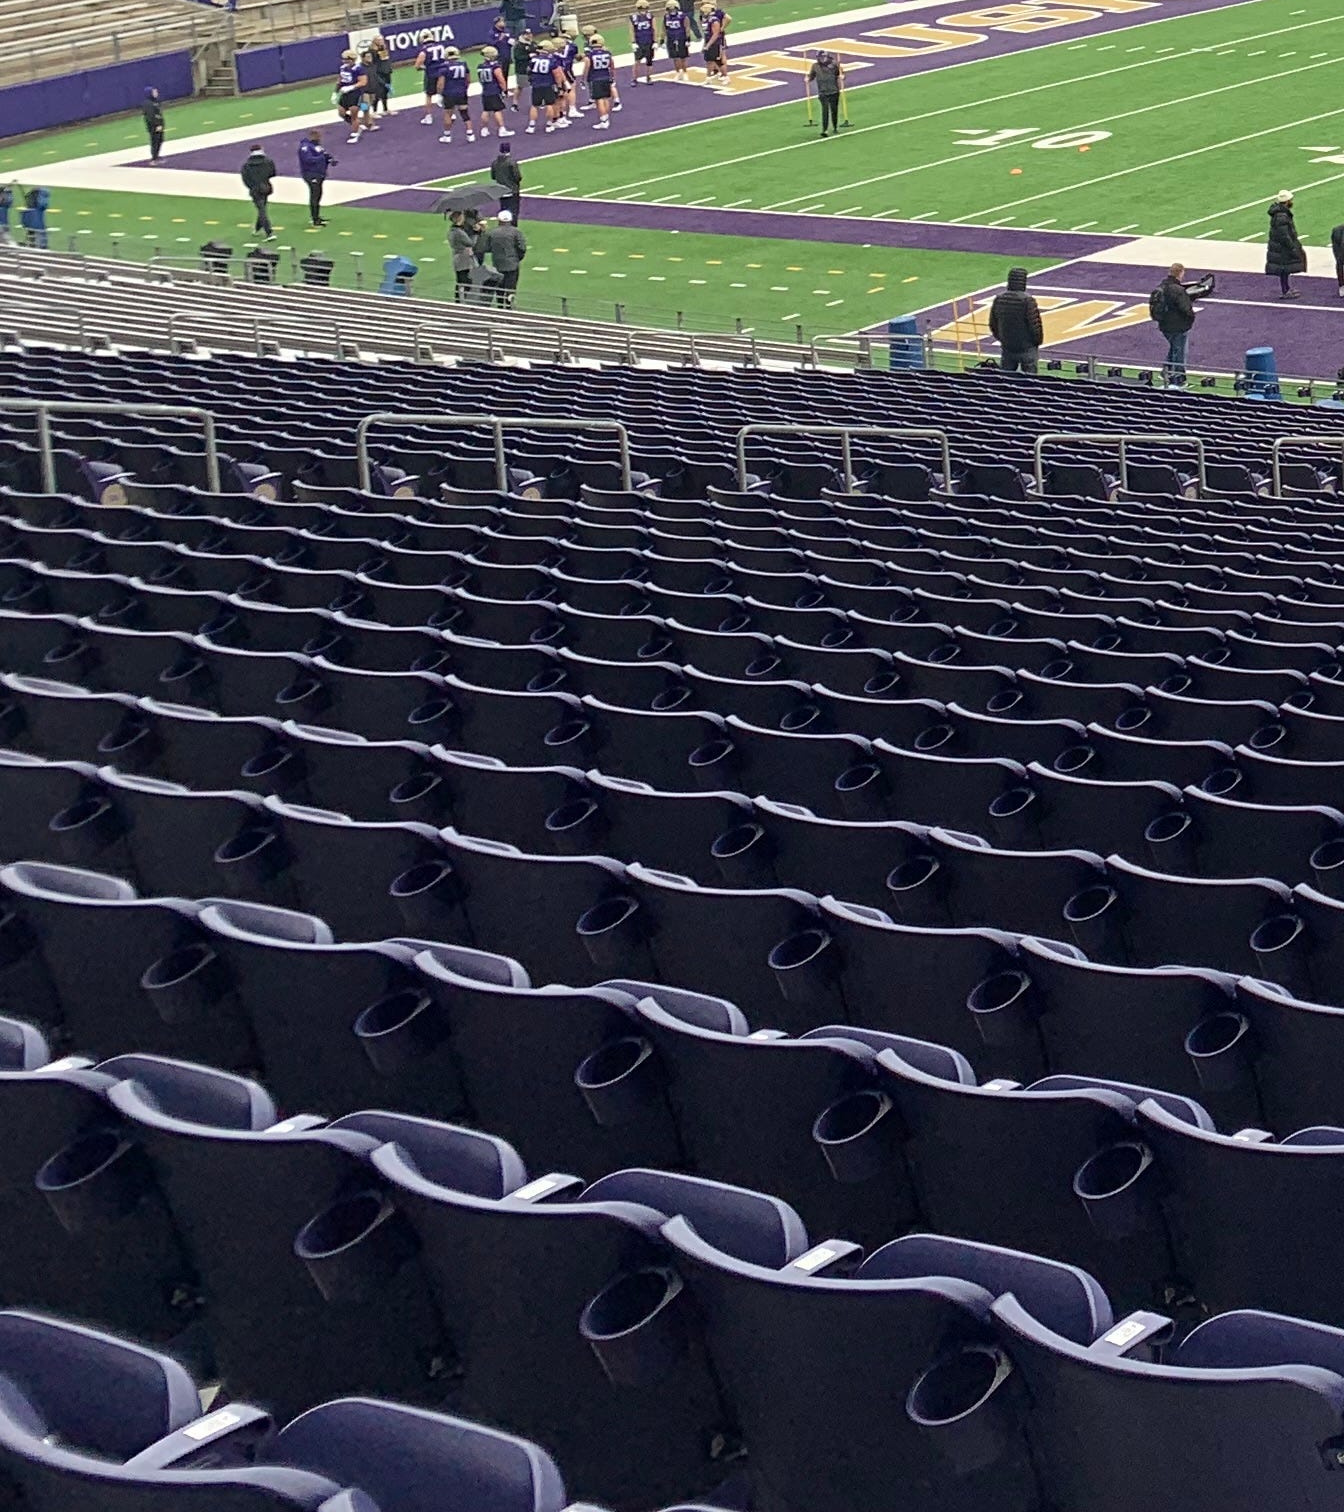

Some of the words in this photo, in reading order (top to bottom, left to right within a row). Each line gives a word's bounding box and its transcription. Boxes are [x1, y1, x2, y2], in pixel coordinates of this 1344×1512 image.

[531, 57, 551, 74] 78
[592, 54, 611, 69] 65
[448, 65, 466, 79] 71
